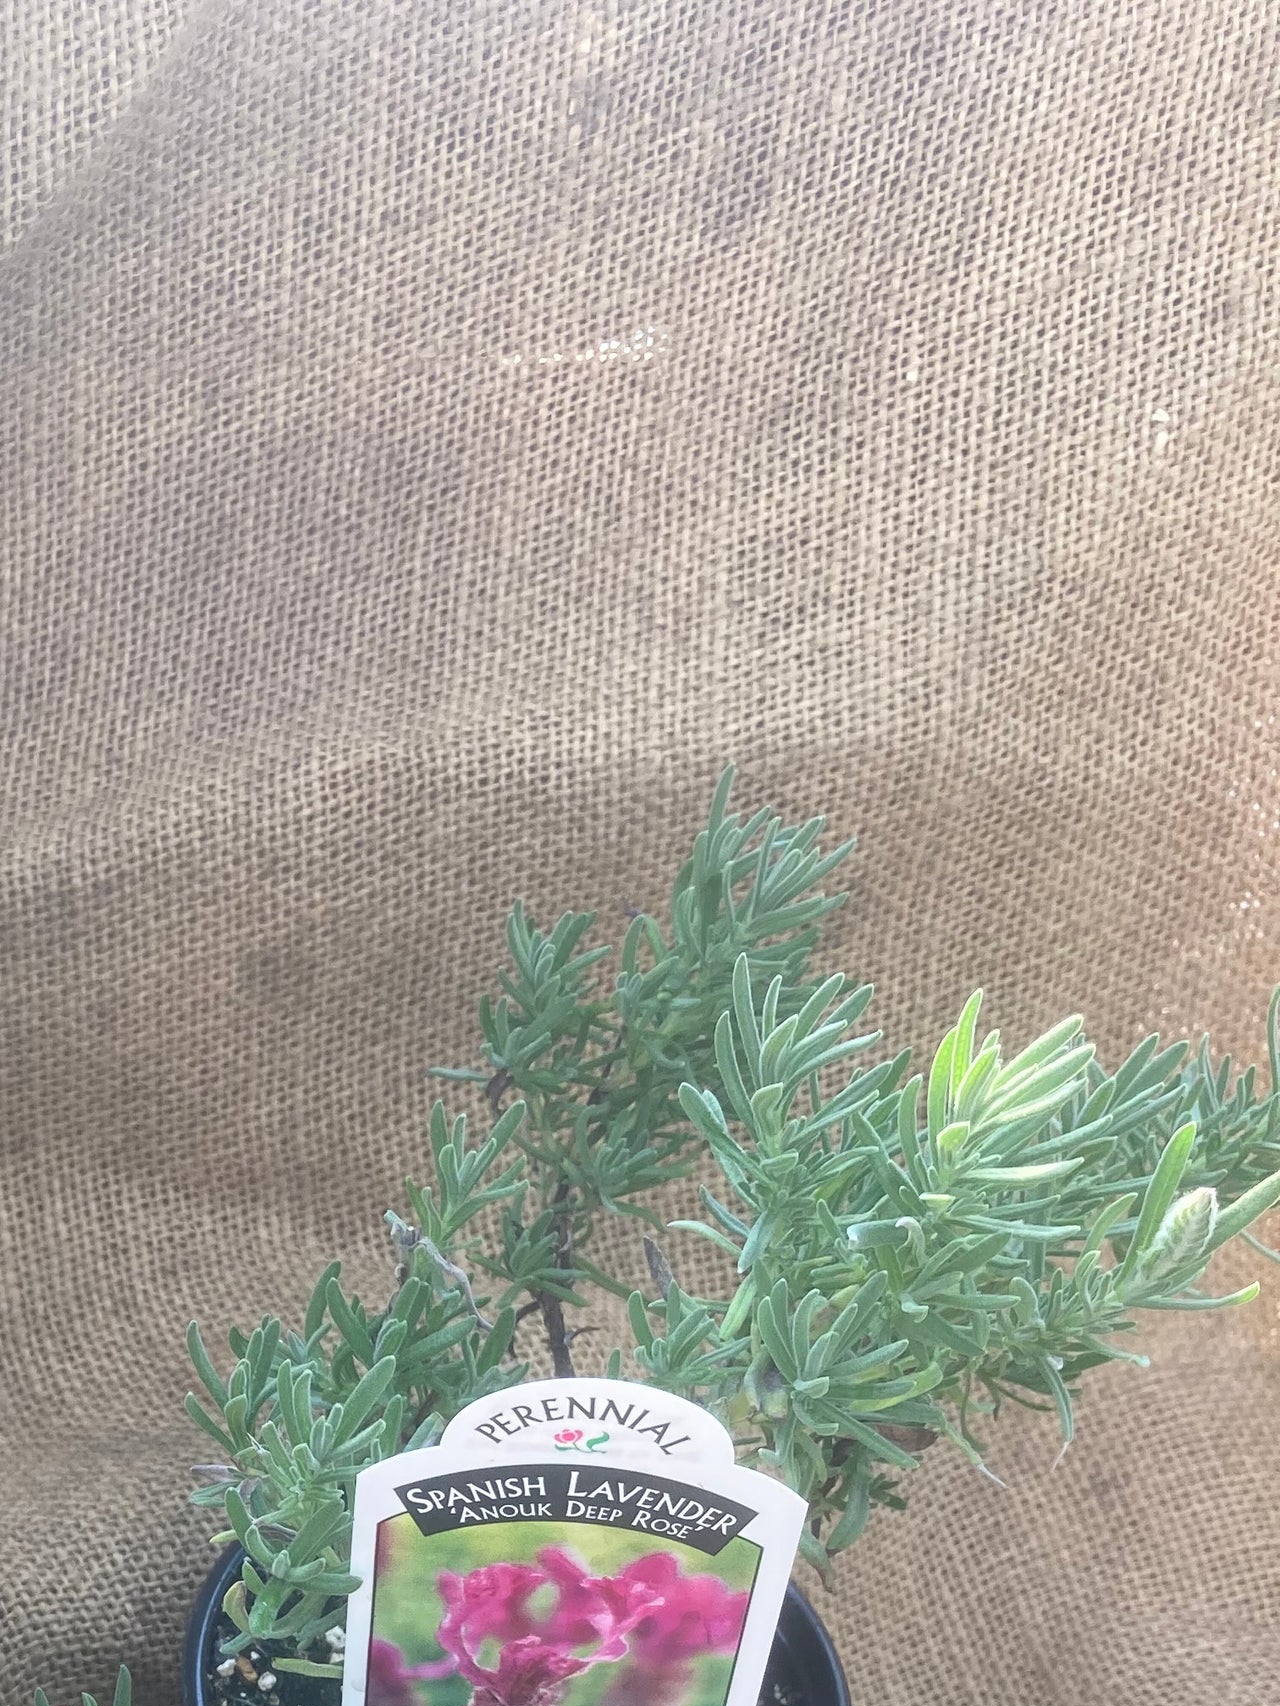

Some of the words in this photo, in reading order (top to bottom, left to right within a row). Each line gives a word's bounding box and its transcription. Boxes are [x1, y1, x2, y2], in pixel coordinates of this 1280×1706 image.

[474, 1396, 692, 1455] PERENNIAL
[405, 1475, 546, 1515] SPANISH
[566, 1470, 737, 1536] LAVENDER
[565, 1500, 623, 1522] DEEP
